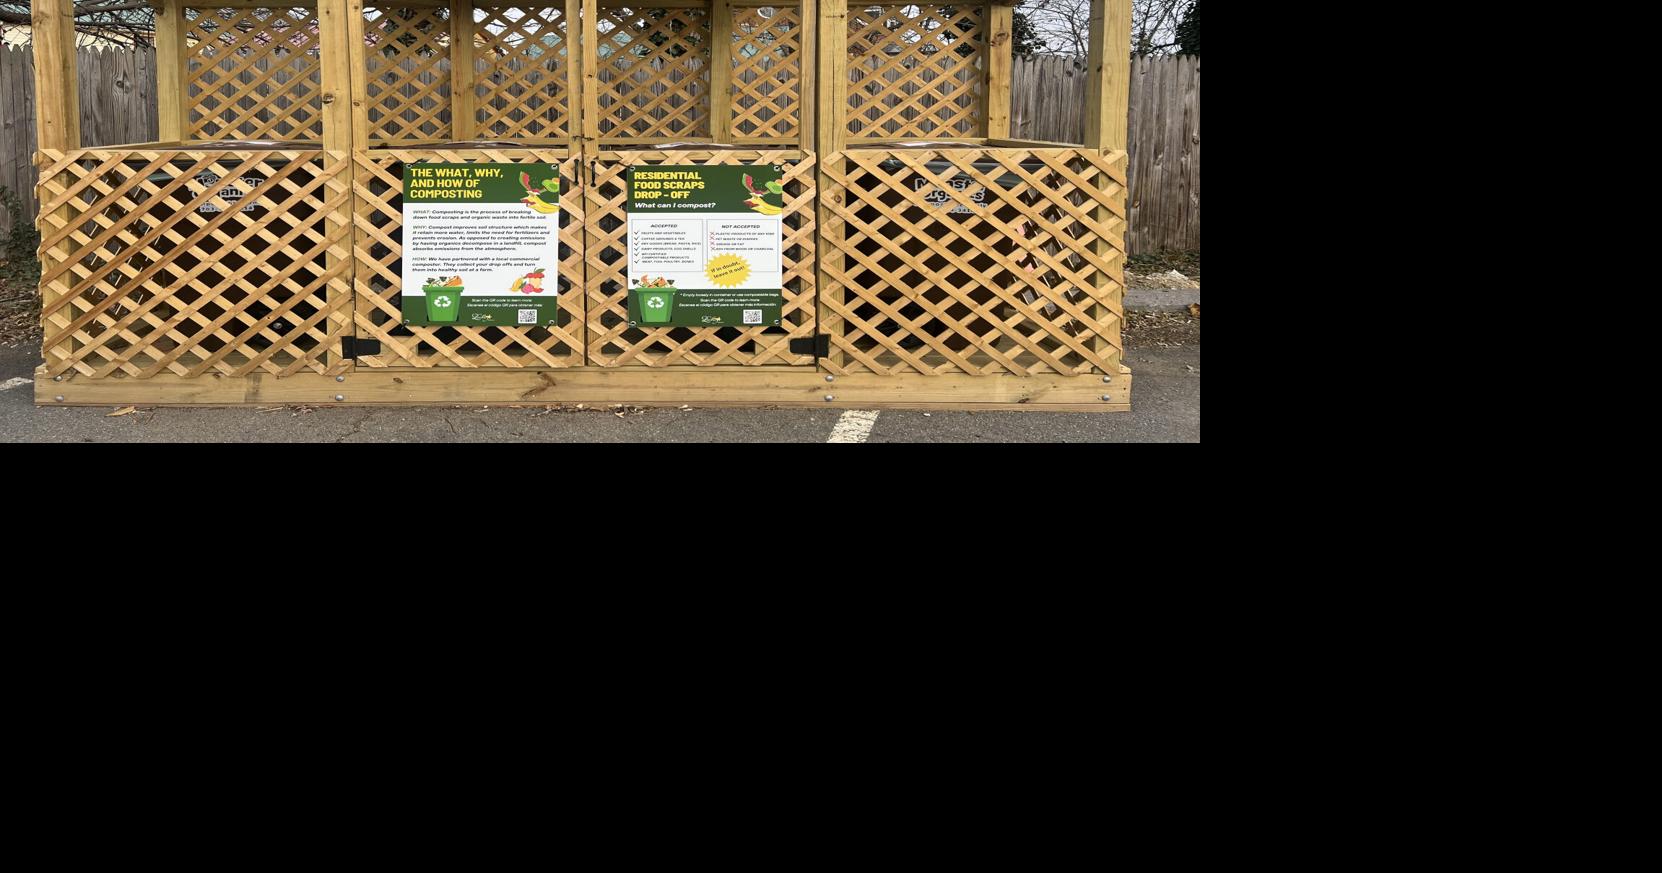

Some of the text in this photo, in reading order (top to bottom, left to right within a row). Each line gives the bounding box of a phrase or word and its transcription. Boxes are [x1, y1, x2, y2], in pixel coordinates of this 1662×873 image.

[410, 168, 504, 178] THE WHAT, WHY,
[634, 172, 702, 180] RESIDENTIAL
[410, 179, 480, 188] AND HOW OF
[662, 181, 704, 189] SCRAPS
[410, 189, 482, 198] COMPOSTING
